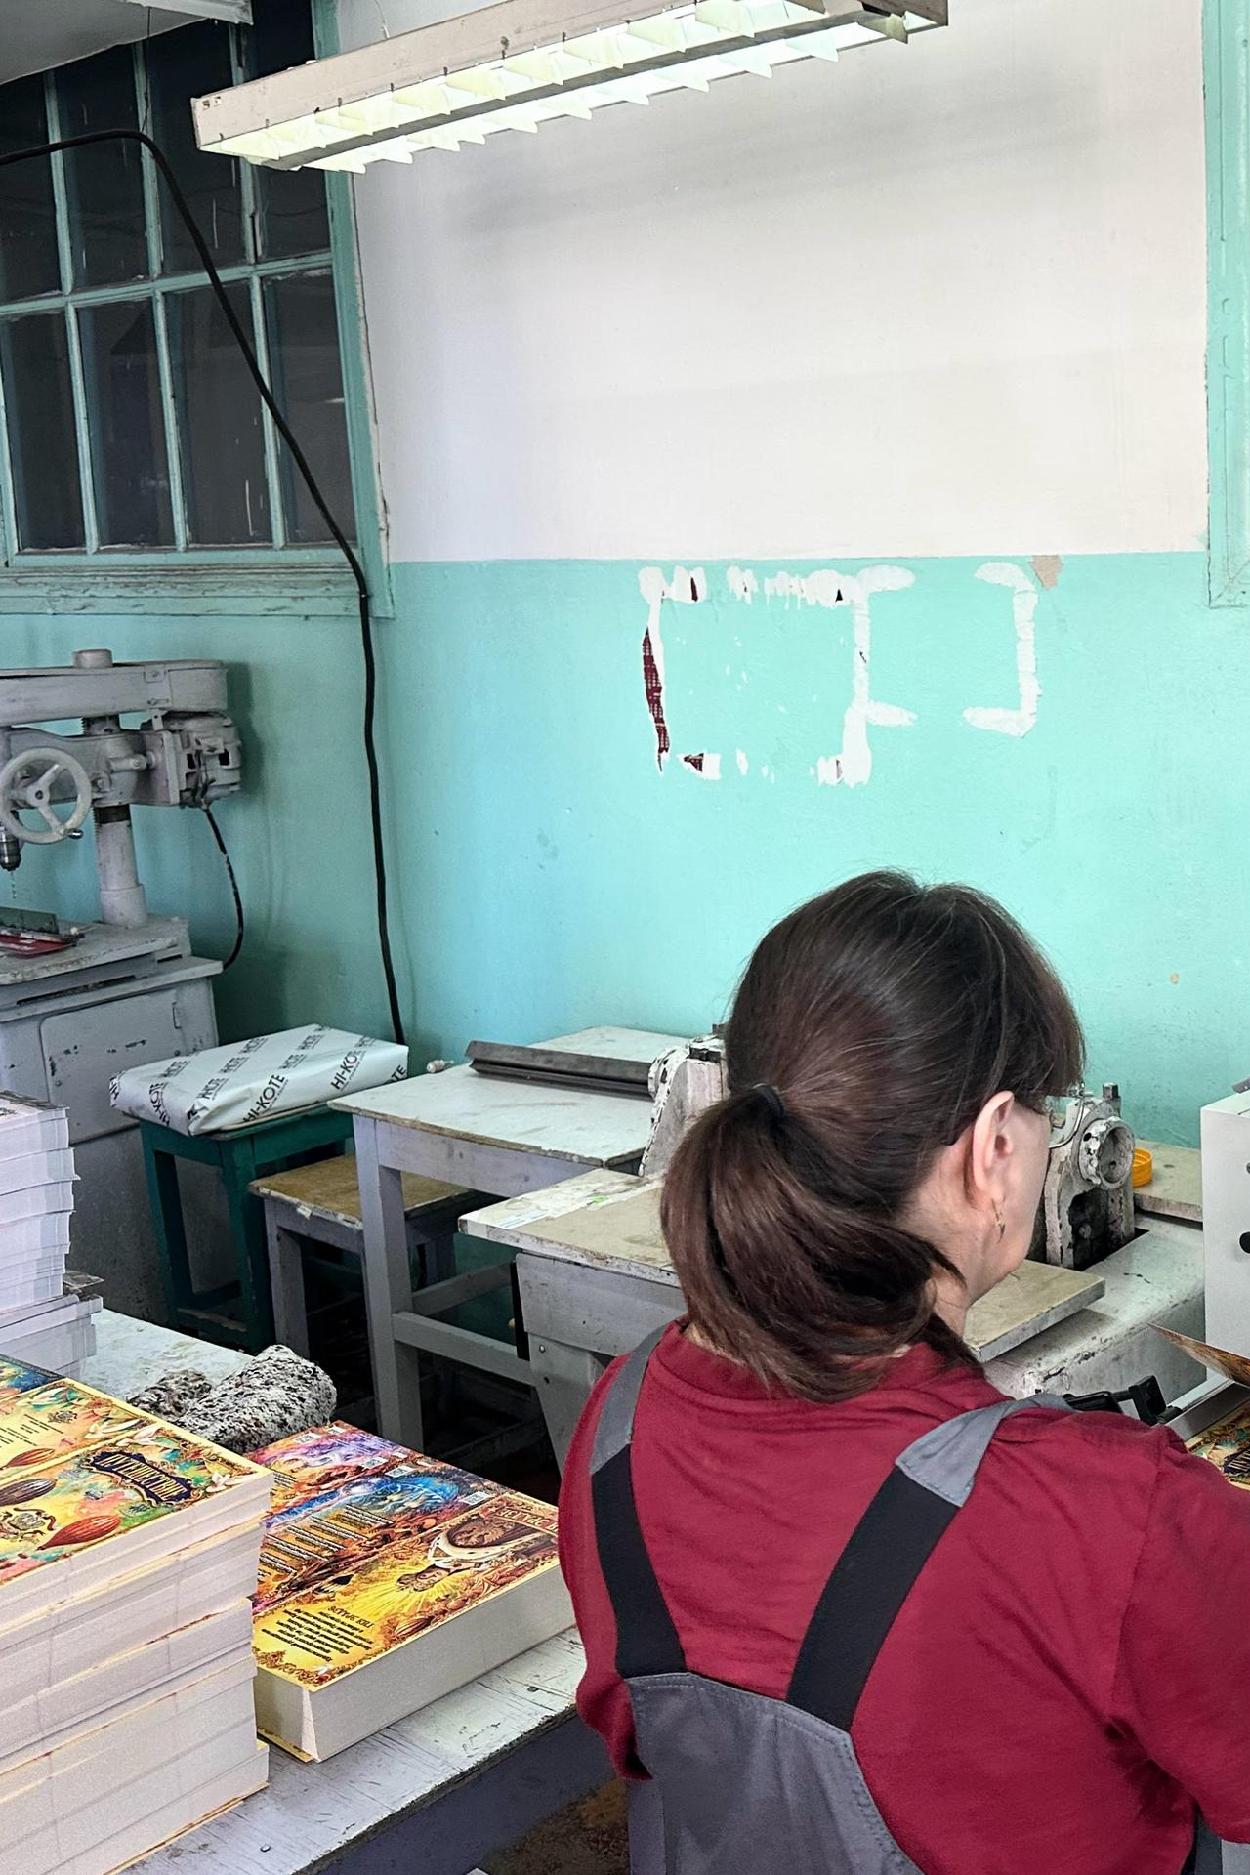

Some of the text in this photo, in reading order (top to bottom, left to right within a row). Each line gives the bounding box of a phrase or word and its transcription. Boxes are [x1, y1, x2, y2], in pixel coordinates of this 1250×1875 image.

[331, 1050, 361, 1090] HI-KO
[243, 1075, 285, 1122] HI-KOTE
[95, 1453, 188, 1501] ПУТЕШЕСТВИЕ
